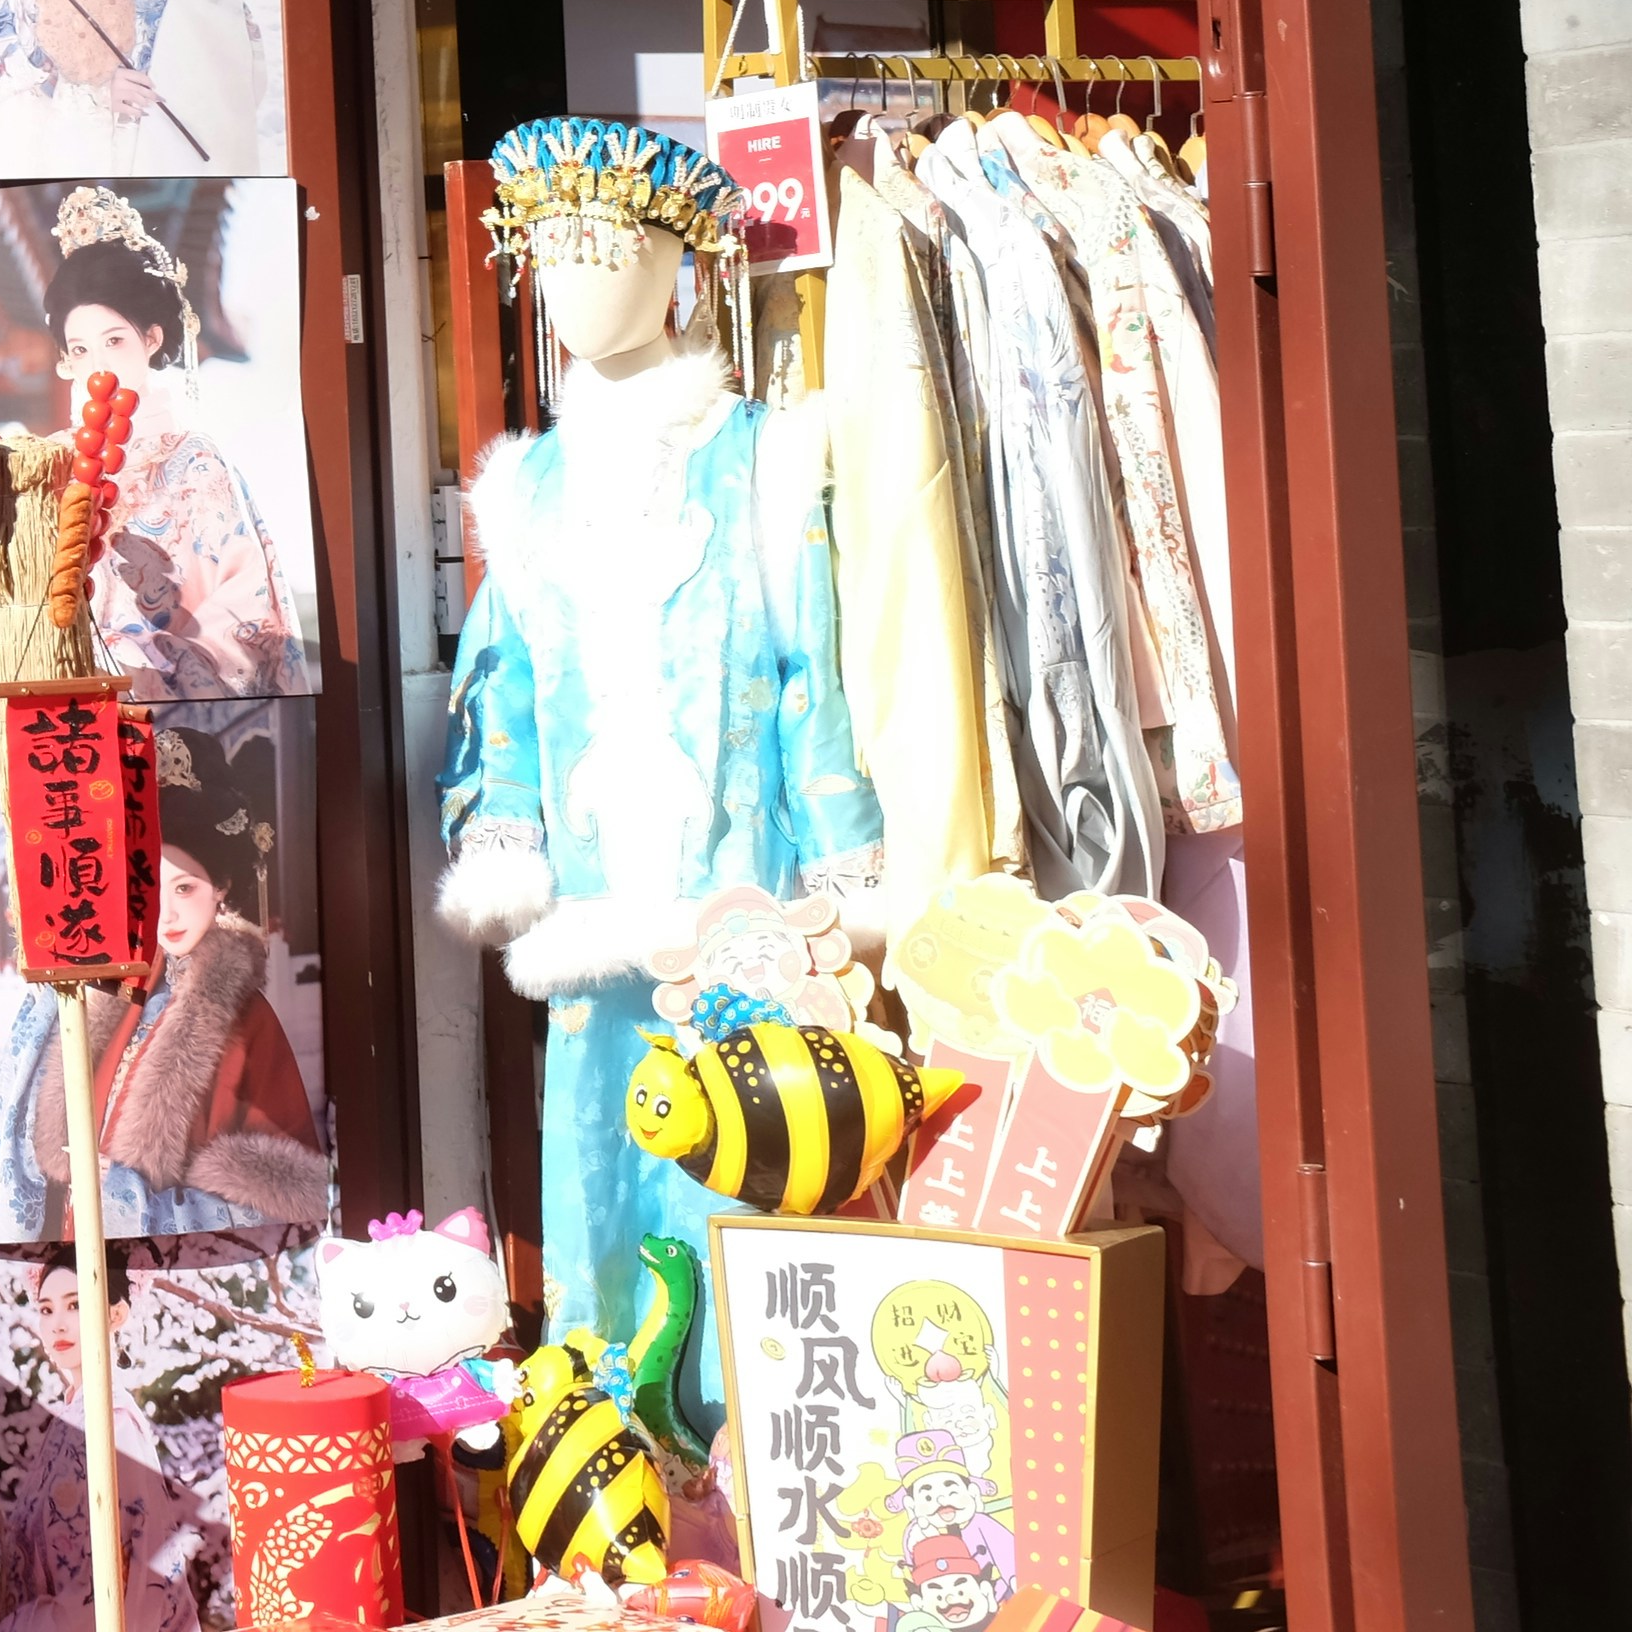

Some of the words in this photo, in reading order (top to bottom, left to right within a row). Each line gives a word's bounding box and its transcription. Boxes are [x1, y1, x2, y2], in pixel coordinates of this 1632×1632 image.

[747, 135, 782, 154] HIRE
[765, 1260, 877, 1632] 顺风顺水顺
